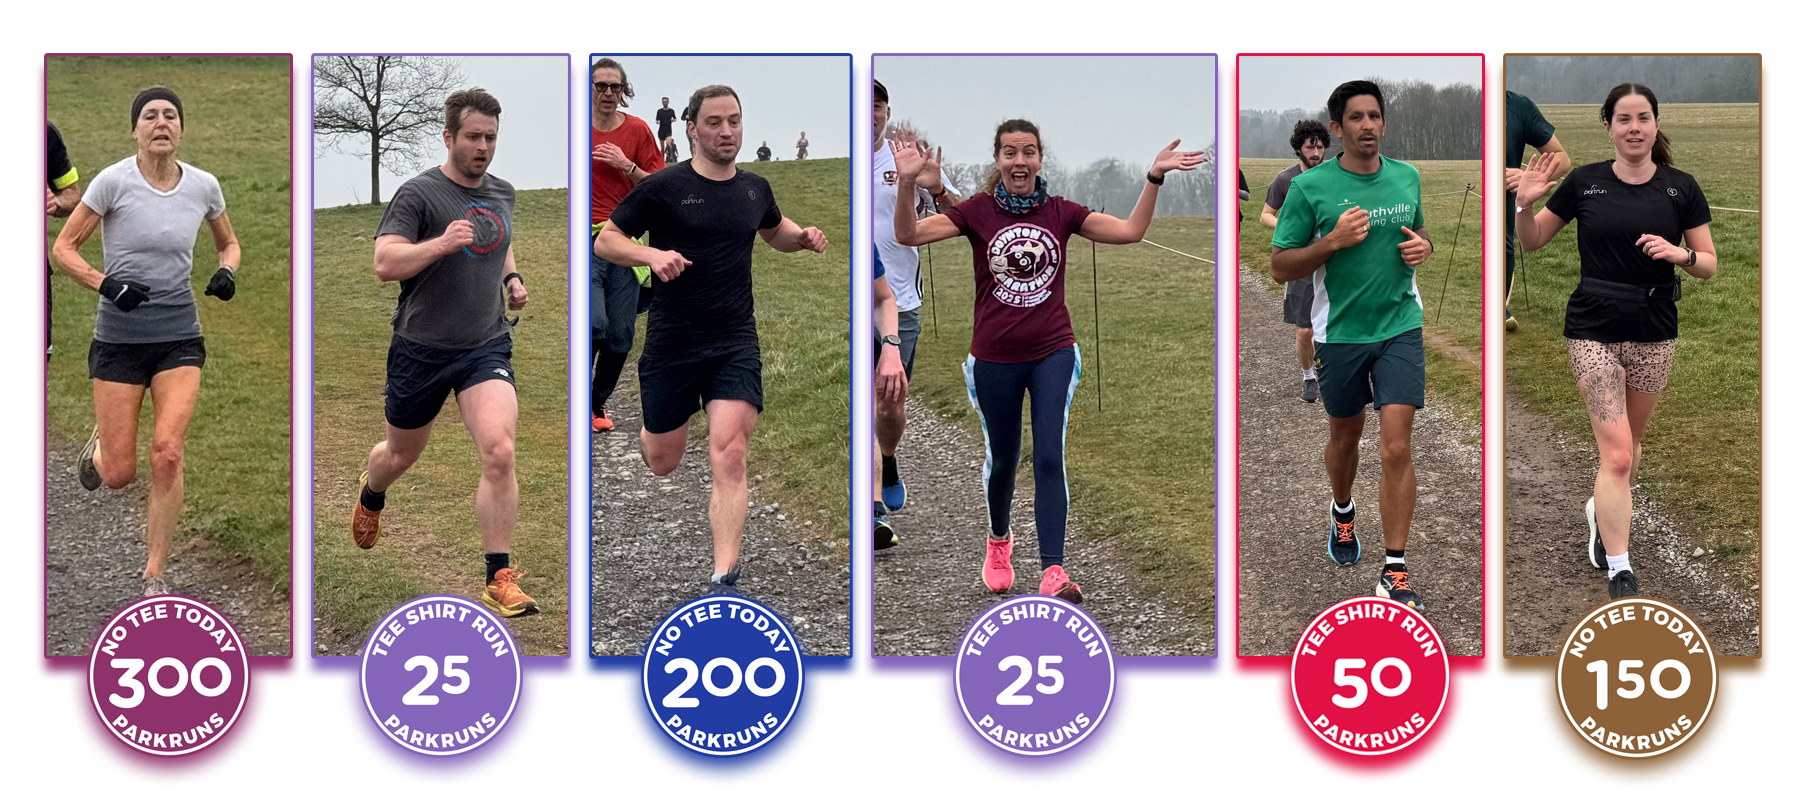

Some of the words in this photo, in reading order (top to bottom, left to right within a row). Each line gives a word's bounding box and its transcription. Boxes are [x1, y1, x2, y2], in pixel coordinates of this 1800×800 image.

[1584, 185, 1607, 195] parkrun
[681, 194, 704, 205] parkrun
[1367, 203, 1411, 219] uthville
[1391, 214, 1411, 224] club
[991, 227, 1041, 255] DOYNTON
[996, 265, 1055, 292] MARATHON
[996, 288, 1021, 304] 2025
